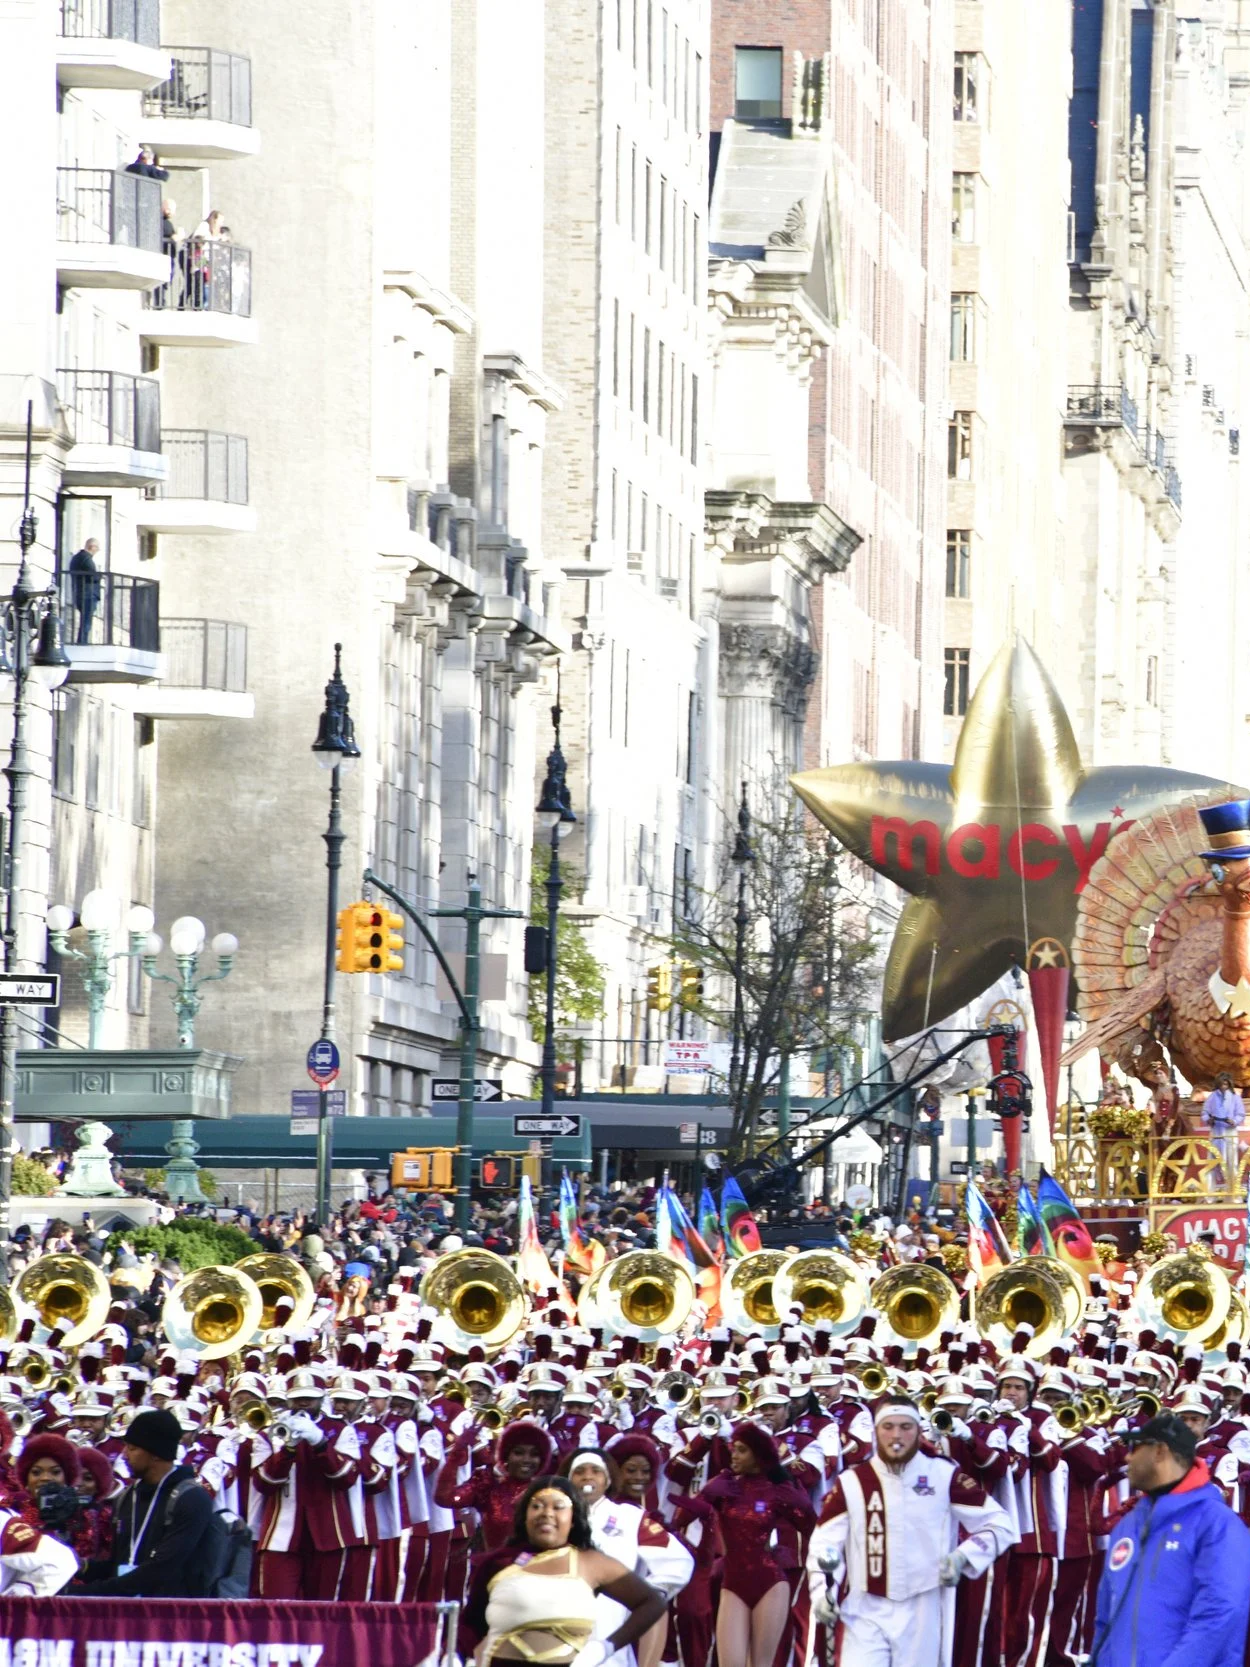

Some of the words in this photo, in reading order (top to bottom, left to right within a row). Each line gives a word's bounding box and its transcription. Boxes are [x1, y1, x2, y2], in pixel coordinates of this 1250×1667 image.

[16, 983, 45, 996] WAY
[523, 1121, 542, 1130] ONE
[551, 1121, 570, 1130] WAY
[867, 1490, 884, 1578] AAMU
[86, 1640, 324, 1667] UNIVERSITY
